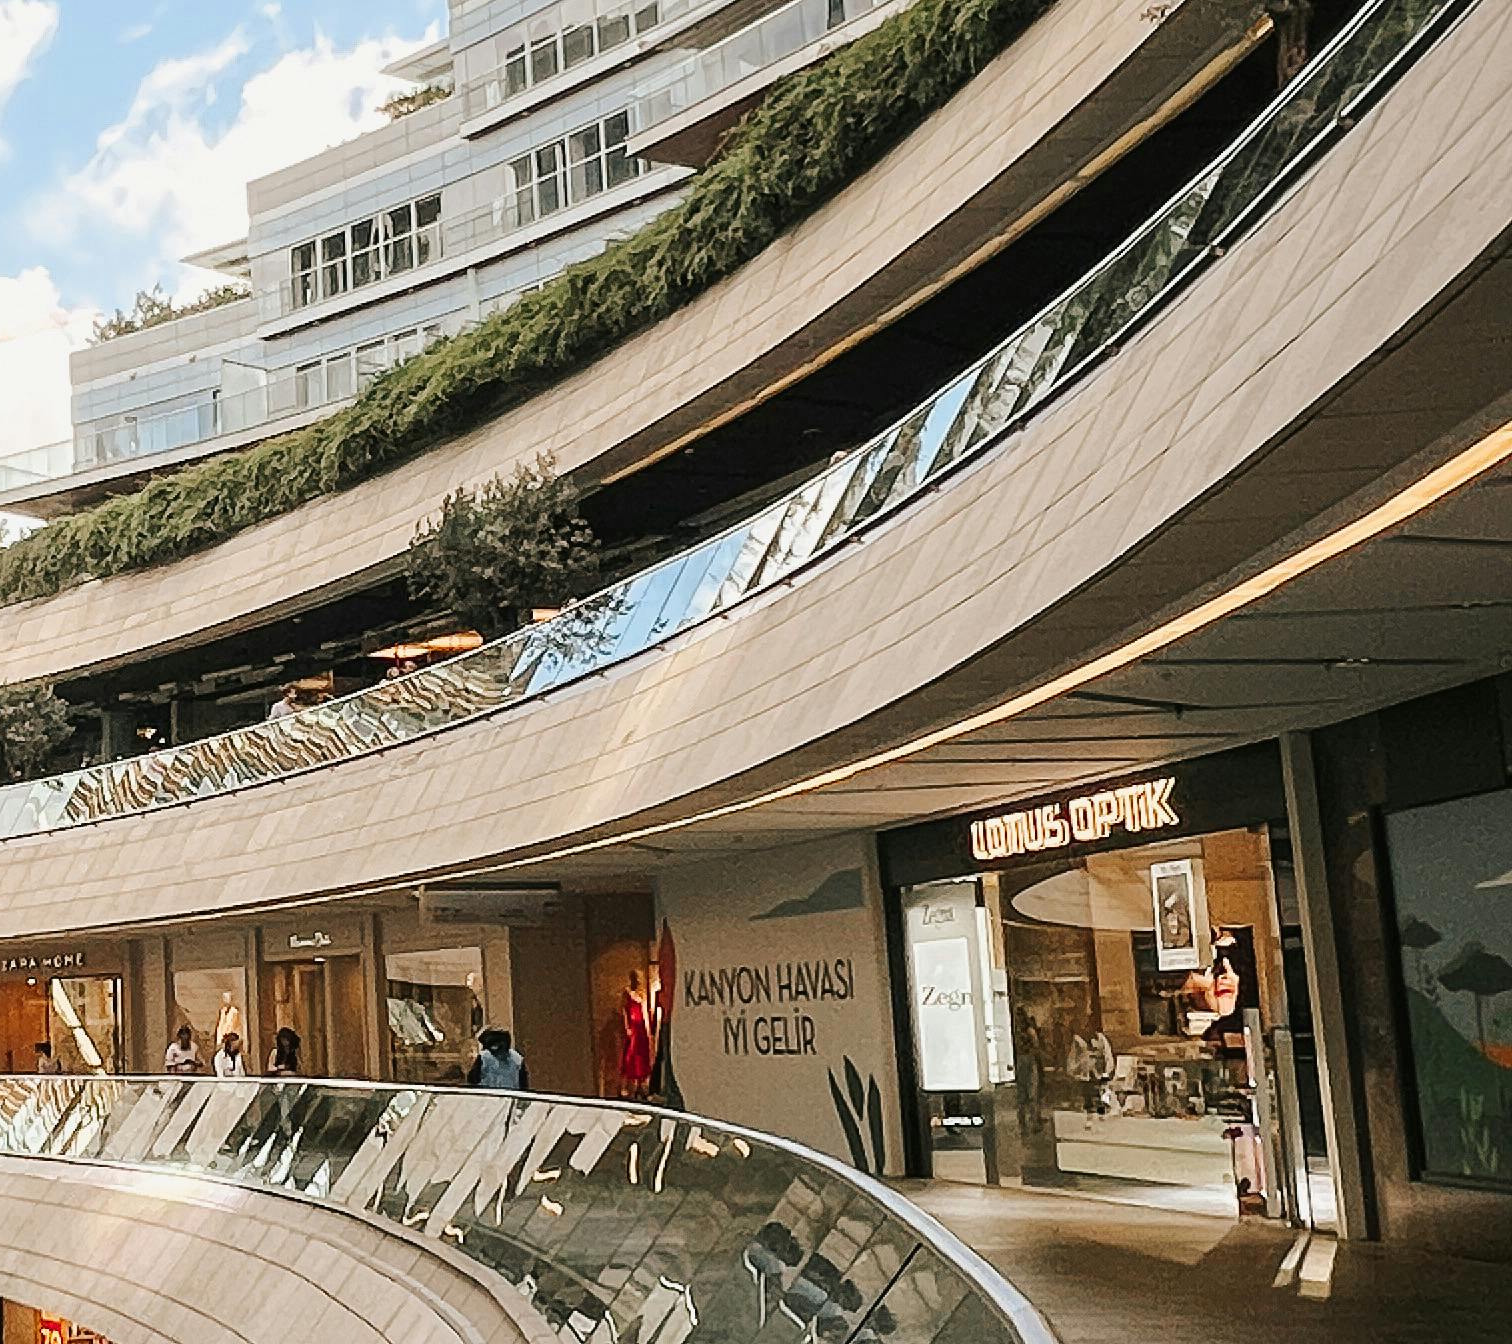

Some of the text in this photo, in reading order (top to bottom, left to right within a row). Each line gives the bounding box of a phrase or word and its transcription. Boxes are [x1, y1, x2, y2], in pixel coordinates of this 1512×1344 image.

[970, 803, 1071, 860] LOTUS
[1, 952, 86, 972] ZARA HOME
[684, 958, 855, 1007] KANYON HAVASI
[753, 1006, 818, 1056] GELİR
